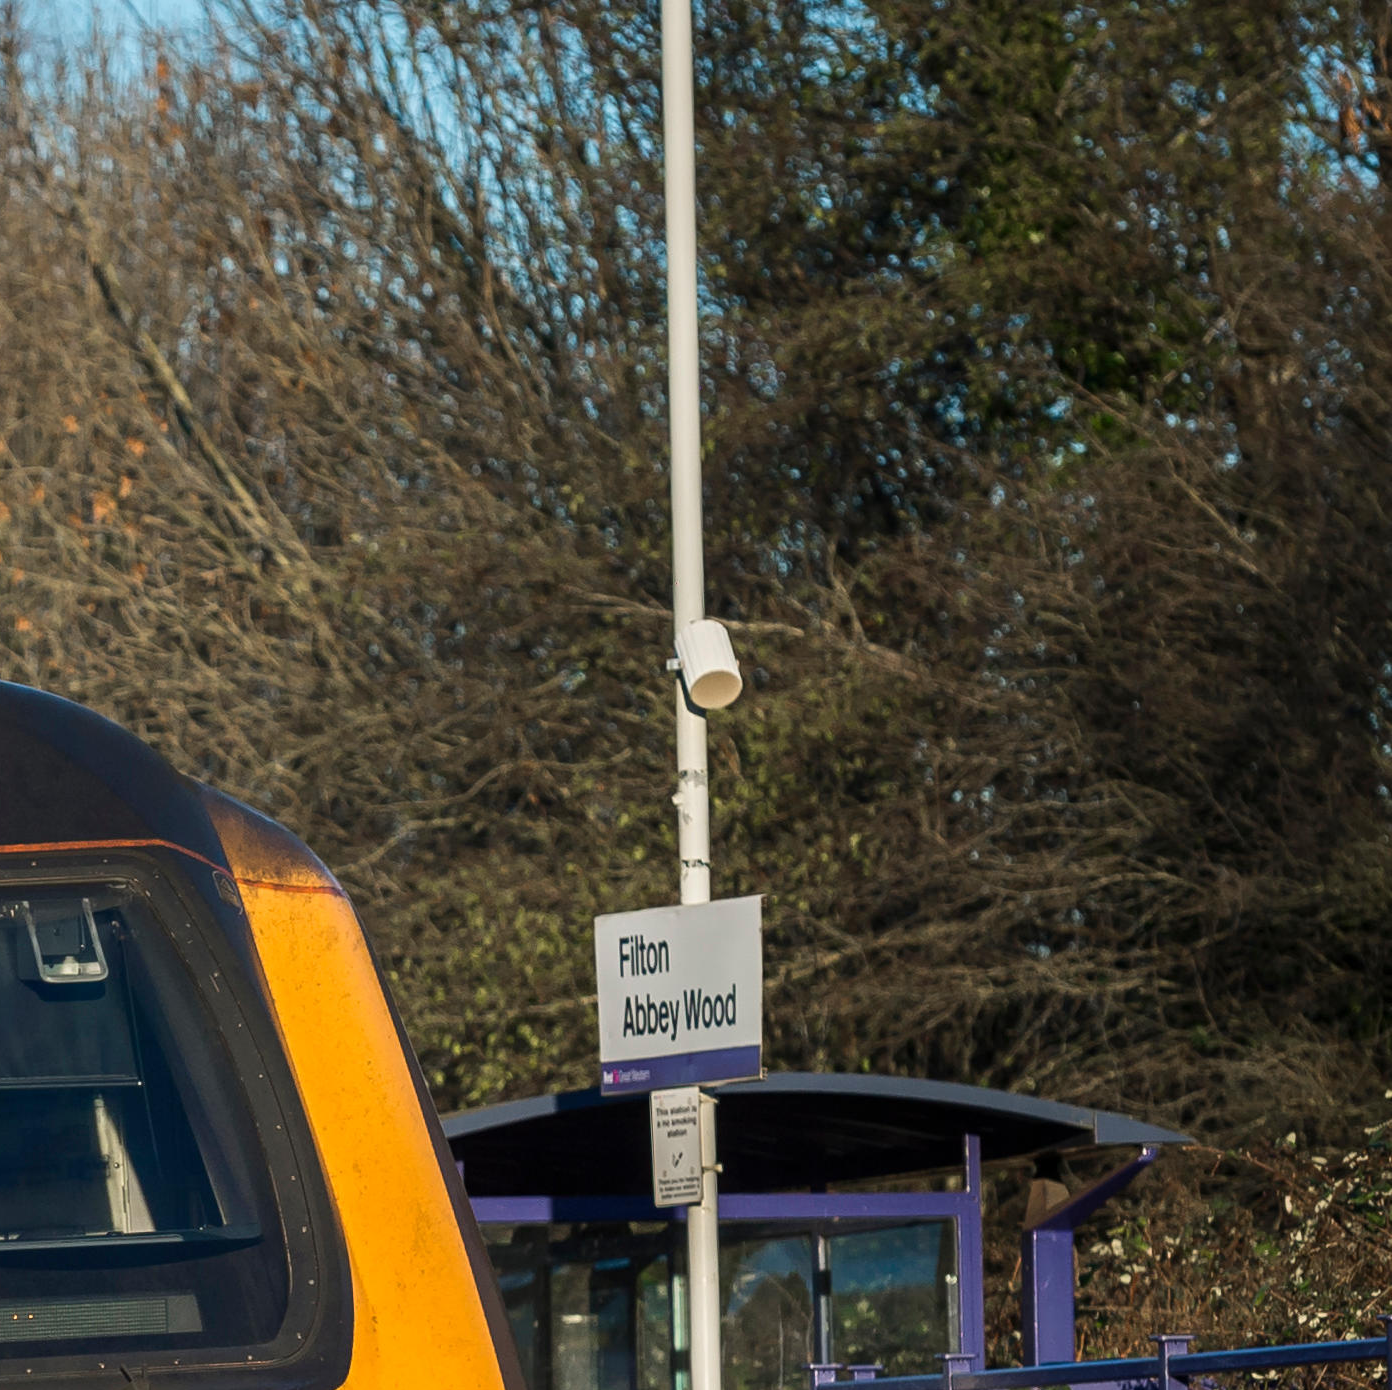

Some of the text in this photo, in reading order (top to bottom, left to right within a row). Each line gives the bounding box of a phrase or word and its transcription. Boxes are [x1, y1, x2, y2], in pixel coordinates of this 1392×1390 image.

[619, 934, 670, 978] Filton
[623, 983, 737, 1042] Abbey Wood
